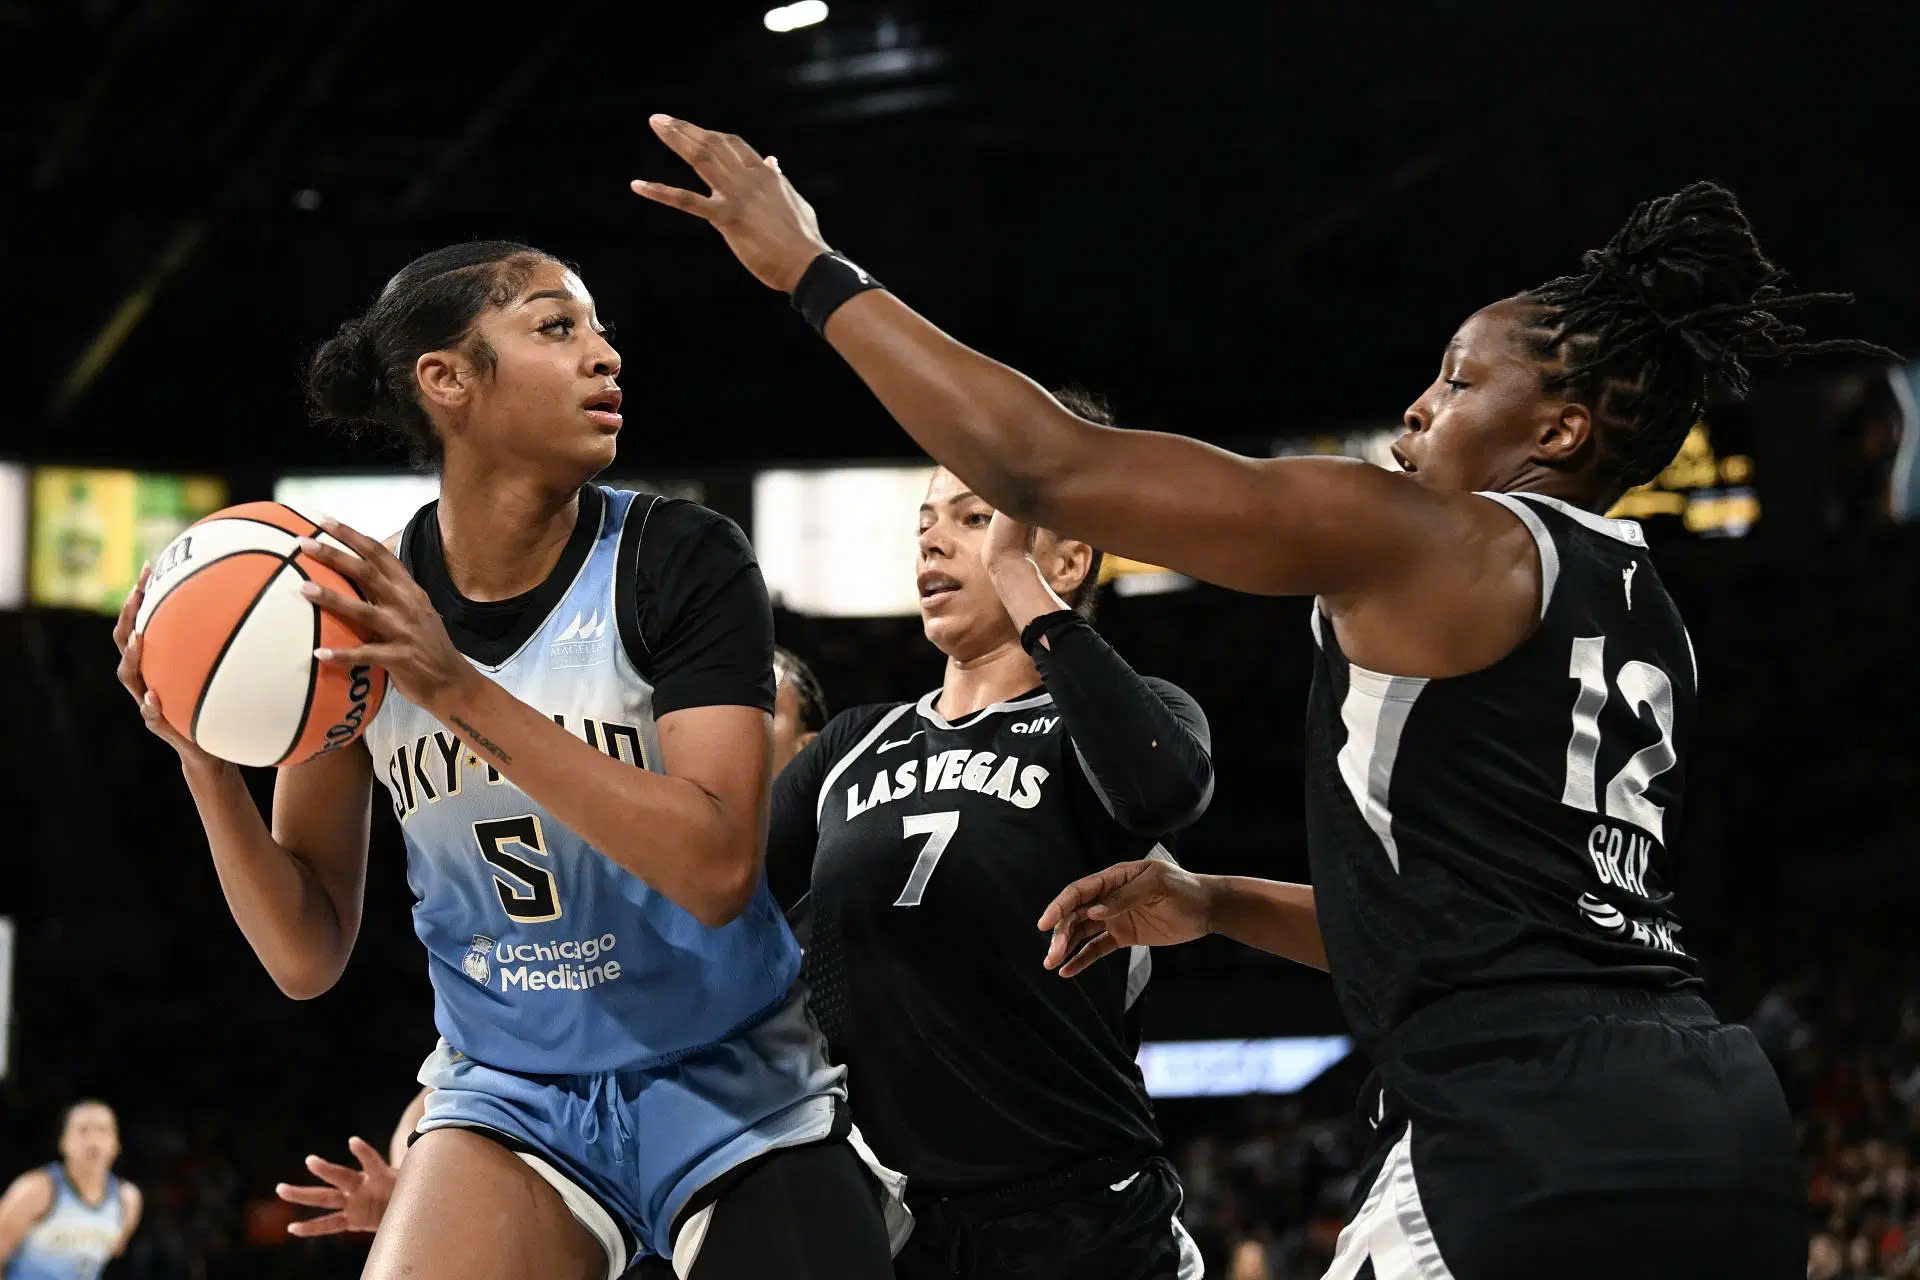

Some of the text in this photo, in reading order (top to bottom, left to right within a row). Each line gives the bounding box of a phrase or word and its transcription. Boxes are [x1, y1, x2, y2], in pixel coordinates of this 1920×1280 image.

[1010, 716, 1060, 734] ally
[1561, 636, 1676, 847] 12
[846, 749, 1050, 822] LAS VEGAS
[473, 814, 562, 924] 5
[893, 810, 960, 907] 7
[1588, 823, 1652, 898] GRAY
[495, 933, 616, 964] UChicago
[501, 960, 621, 992] Medicine
